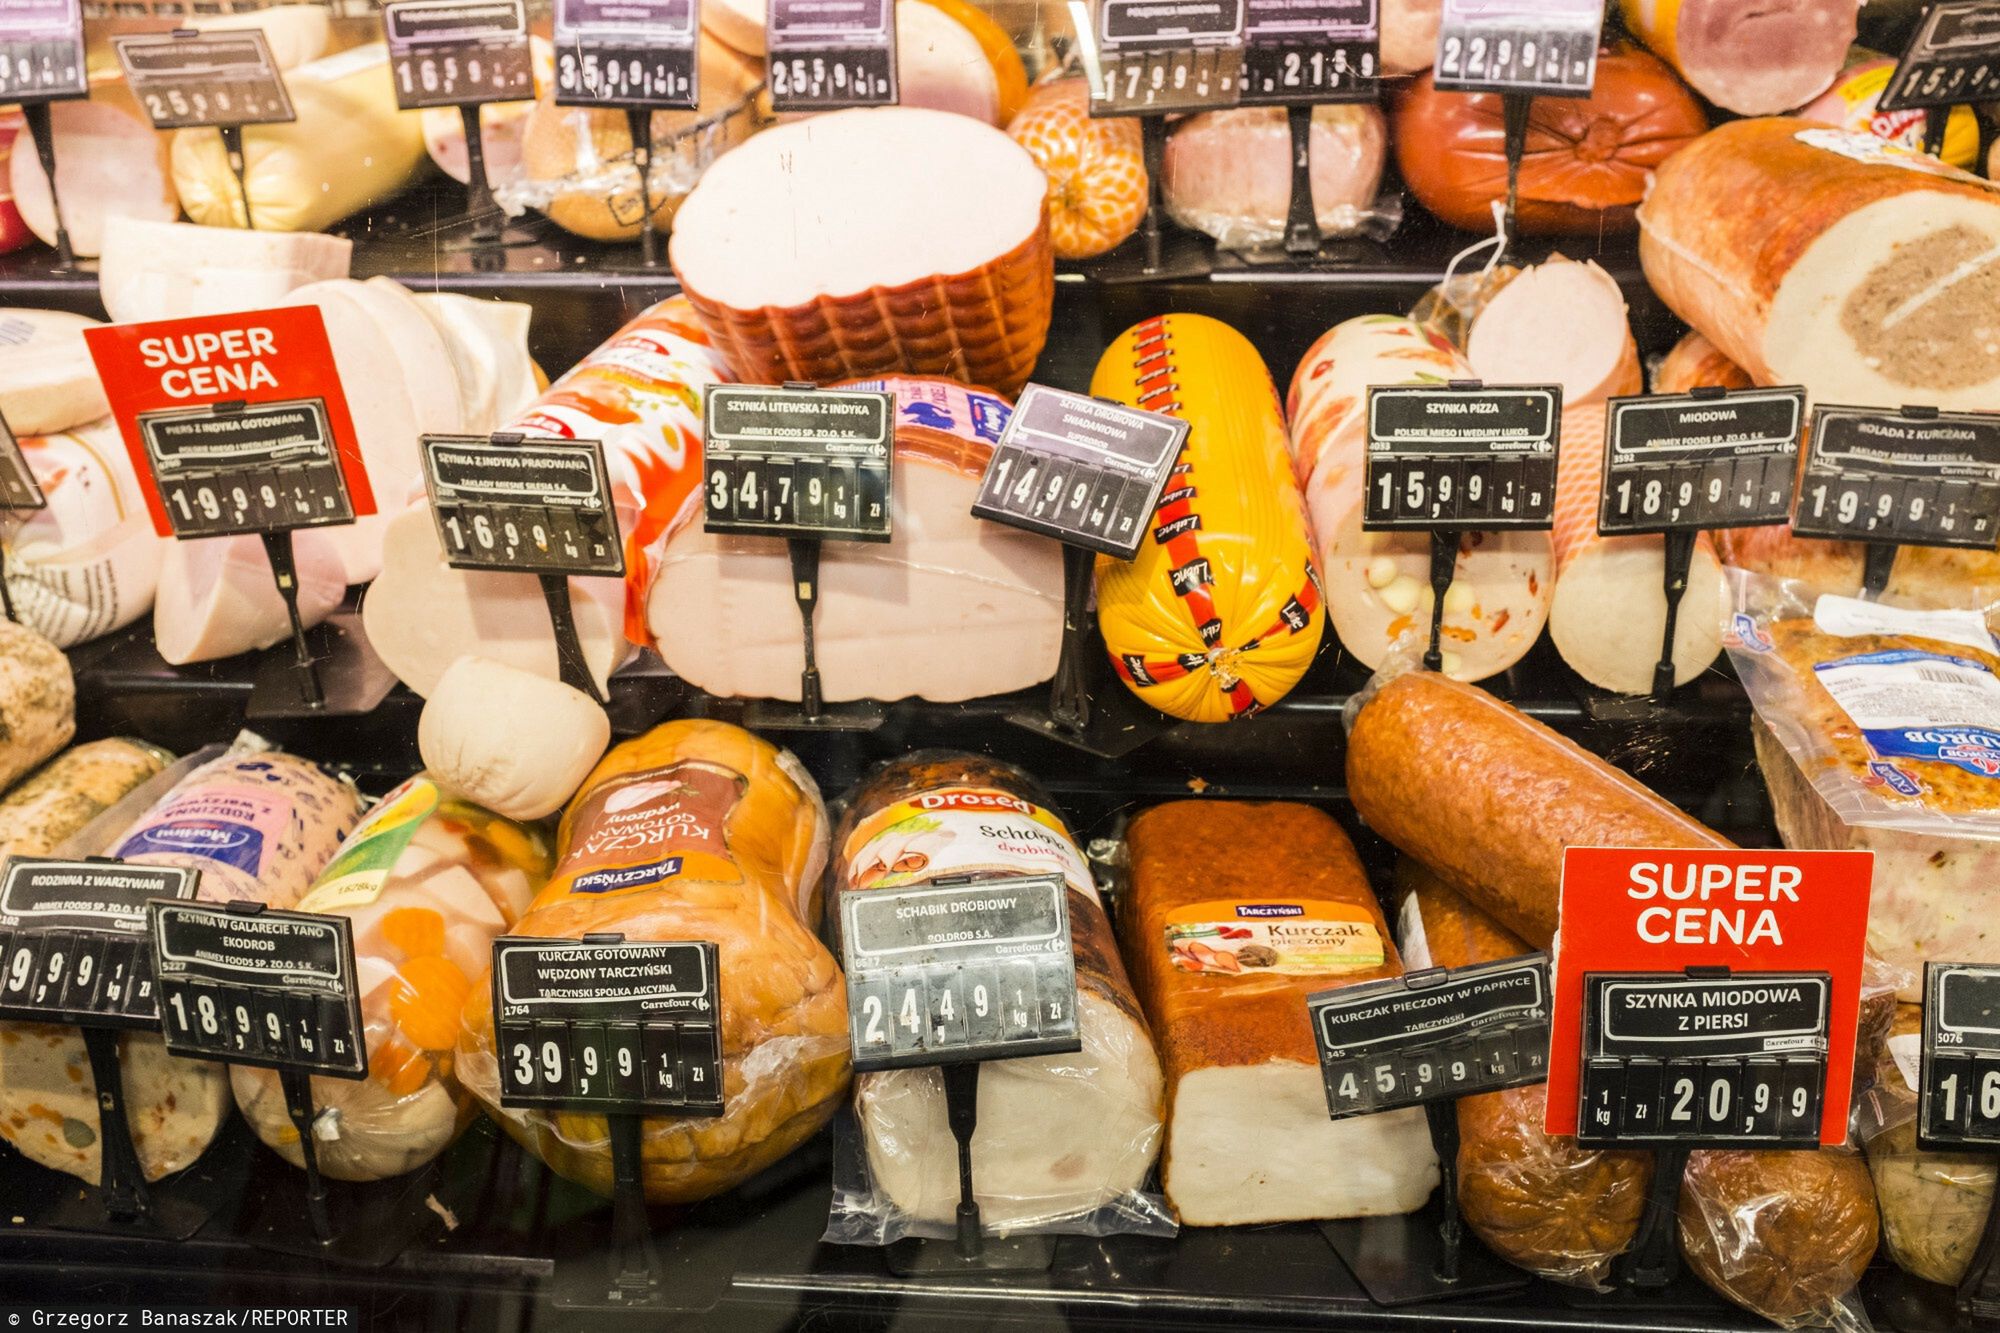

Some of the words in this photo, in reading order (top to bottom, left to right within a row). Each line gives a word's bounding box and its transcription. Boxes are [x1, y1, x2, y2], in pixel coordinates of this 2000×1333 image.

[1442, 37, 1536, 80] 22,99
[139, 327, 278, 368] SUPER
[160, 361, 279, 398] CENA
[727, 401, 767, 413] SZYNKA
[768, 401, 821, 414] LITEWSKA
[821, 404, 828, 414] Z
[828, 403, 870, 416] INDYKA
[1094, 405, 1145, 431] DROBIOWA
[1426, 403, 1468, 414] SZYNKA
[1469, 402, 1499, 414] PIZZA
[1679, 409, 1738, 424] MIODOWA
[194, 424, 202, 433] Z
[202, 421, 240, 433] INDYKA
[241, 414, 305, 430] GOTOWANA
[739, 427, 773, 436] ANIMEX
[774, 427, 802, 437] FOODS
[802, 428, 815, 437] SP.
[1394, 428, 1429, 437] POLSKIE
[1429, 428, 1457, 438] MIESO
[1462, 428, 1501, 437] WEDLINY
[1646, 437, 1681, 447] ANIMEX
[1681, 435, 1711, 446] FOODS
[1906, 429, 1915, 439] Z
[1915, 428, 1977, 441] KURCZAKA
[825, 443, 868, 453] Carrefour
[1490, 441, 1532, 451] Carrefour
[1734, 444, 1776, 455] Carrefour
[438, 452, 475, 466] SZYNKA
[475, 456, 483, 466] Z
[483, 456, 520, 468] INDYKA
[521, 458, 588, 471] PRASOWANA
[1104, 456, 1141, 474] Carrefour
[1940, 467, 1986, 477] Carrefour
[710, 470, 822, 521] 34,79
[992, 458, 1088, 518] 14,99
[1378, 471, 1482, 519] 15,99
[172, 485, 276, 525] 19,99
[542, 495, 583, 507] Carrefour
[1617, 478, 1722, 522] 18,99
[1812, 485, 1925, 531] 19,99
[447, 514, 548, 561] 16,99
[921, 792, 1031, 815] Drosed
[591, 814, 697, 843] GOTOWANY
[571, 823, 710, 859] KURCZAK
[31, 875, 83, 887] RODZINNA
[84, 876, 93, 887] Z
[93, 876, 165, 891] WARZYWAMI
[575, 859, 677, 888] TARCZYŃSKI
[1627, 862, 1803, 902] SUPER
[32, 901, 64, 911] ANIMEX
[63, 901, 93, 911] FOODS
[896, 902, 949, 920] SCHABIK
[950, 897, 1017, 913] DROBIOWY
[1237, 905, 1303, 916] TARCZYŃSKI
[177, 911, 217, 928] SZYNKA
[217, 917, 231, 929] W
[230, 919, 291, 936] GALARECIE
[292, 924, 324, 938] YANO
[975, 929, 994, 941] S.A.
[1267, 924, 1364, 937] Kurczak
[1636, 906, 1784, 946] CENA
[222, 935, 276, 951] EKODROB
[995, 943, 1043, 955] Carrefour
[1270, 937, 1346, 948] piezony
[195, 950, 225, 963] ANIMEX
[225, 955, 254, 967] FOODS
[254, 957, 269, 968] SP.
[297, 960, 315, 970] S.K.
[538, 949, 593, 962] KURCZAK
[594, 947, 667, 962] GOTOWANY
[0, 945, 93, 1003] 9,99
[161, 962, 187, 972] 5227
[282, 974, 328, 987] Carrefour
[537, 967, 597, 983] WĘDZONY
[598, 962, 673, 979] TARCZYŃSKI
[538, 987, 594, 998] TARCZYNSKI
[594, 985, 632, 998] SPOLKA
[633, 983, 678, 996] AKCYJNA
[1331, 1004, 1390, 1026] KURCZAK
[1393, 992, 1455, 1014] PIECZONY
[1457, 987, 1472, 1000] W
[1473, 976, 1532, 997] PAPRYCE
[1625, 992, 1698, 1010] SZYNKA
[1702, 988, 1802, 1008] MIODOWA
[503, 1004, 530, 1017] 1764
[640, 998, 691, 1011] Carrefour
[862, 984, 989, 1045] 24,49
[170, 992, 282, 1051] 18,99
[1404, 1012, 1466, 1033] TARCZYŃSKI
[1471, 1009, 1522, 1028] Carrefour
[1678, 1016, 1689, 1032] Z
[1694, 1012, 1749, 1031] PIERSI
[1765, 1038, 1806, 1048] Carrefour
[1937, 1032, 1964, 1044] 5076
[513, 1041, 633, 1096] 39,99
[658, 1071, 673, 1090] kg
[691, 1066, 705, 1082] zł
[1338, 1061, 1467, 1101] 45,99
[1595, 1107, 1611, 1126] kg
[1635, 1103, 1648, 1120] zł
[1670, 1078, 1808, 1134] 20,99
[1940, 1070, 2000, 1122] 16
